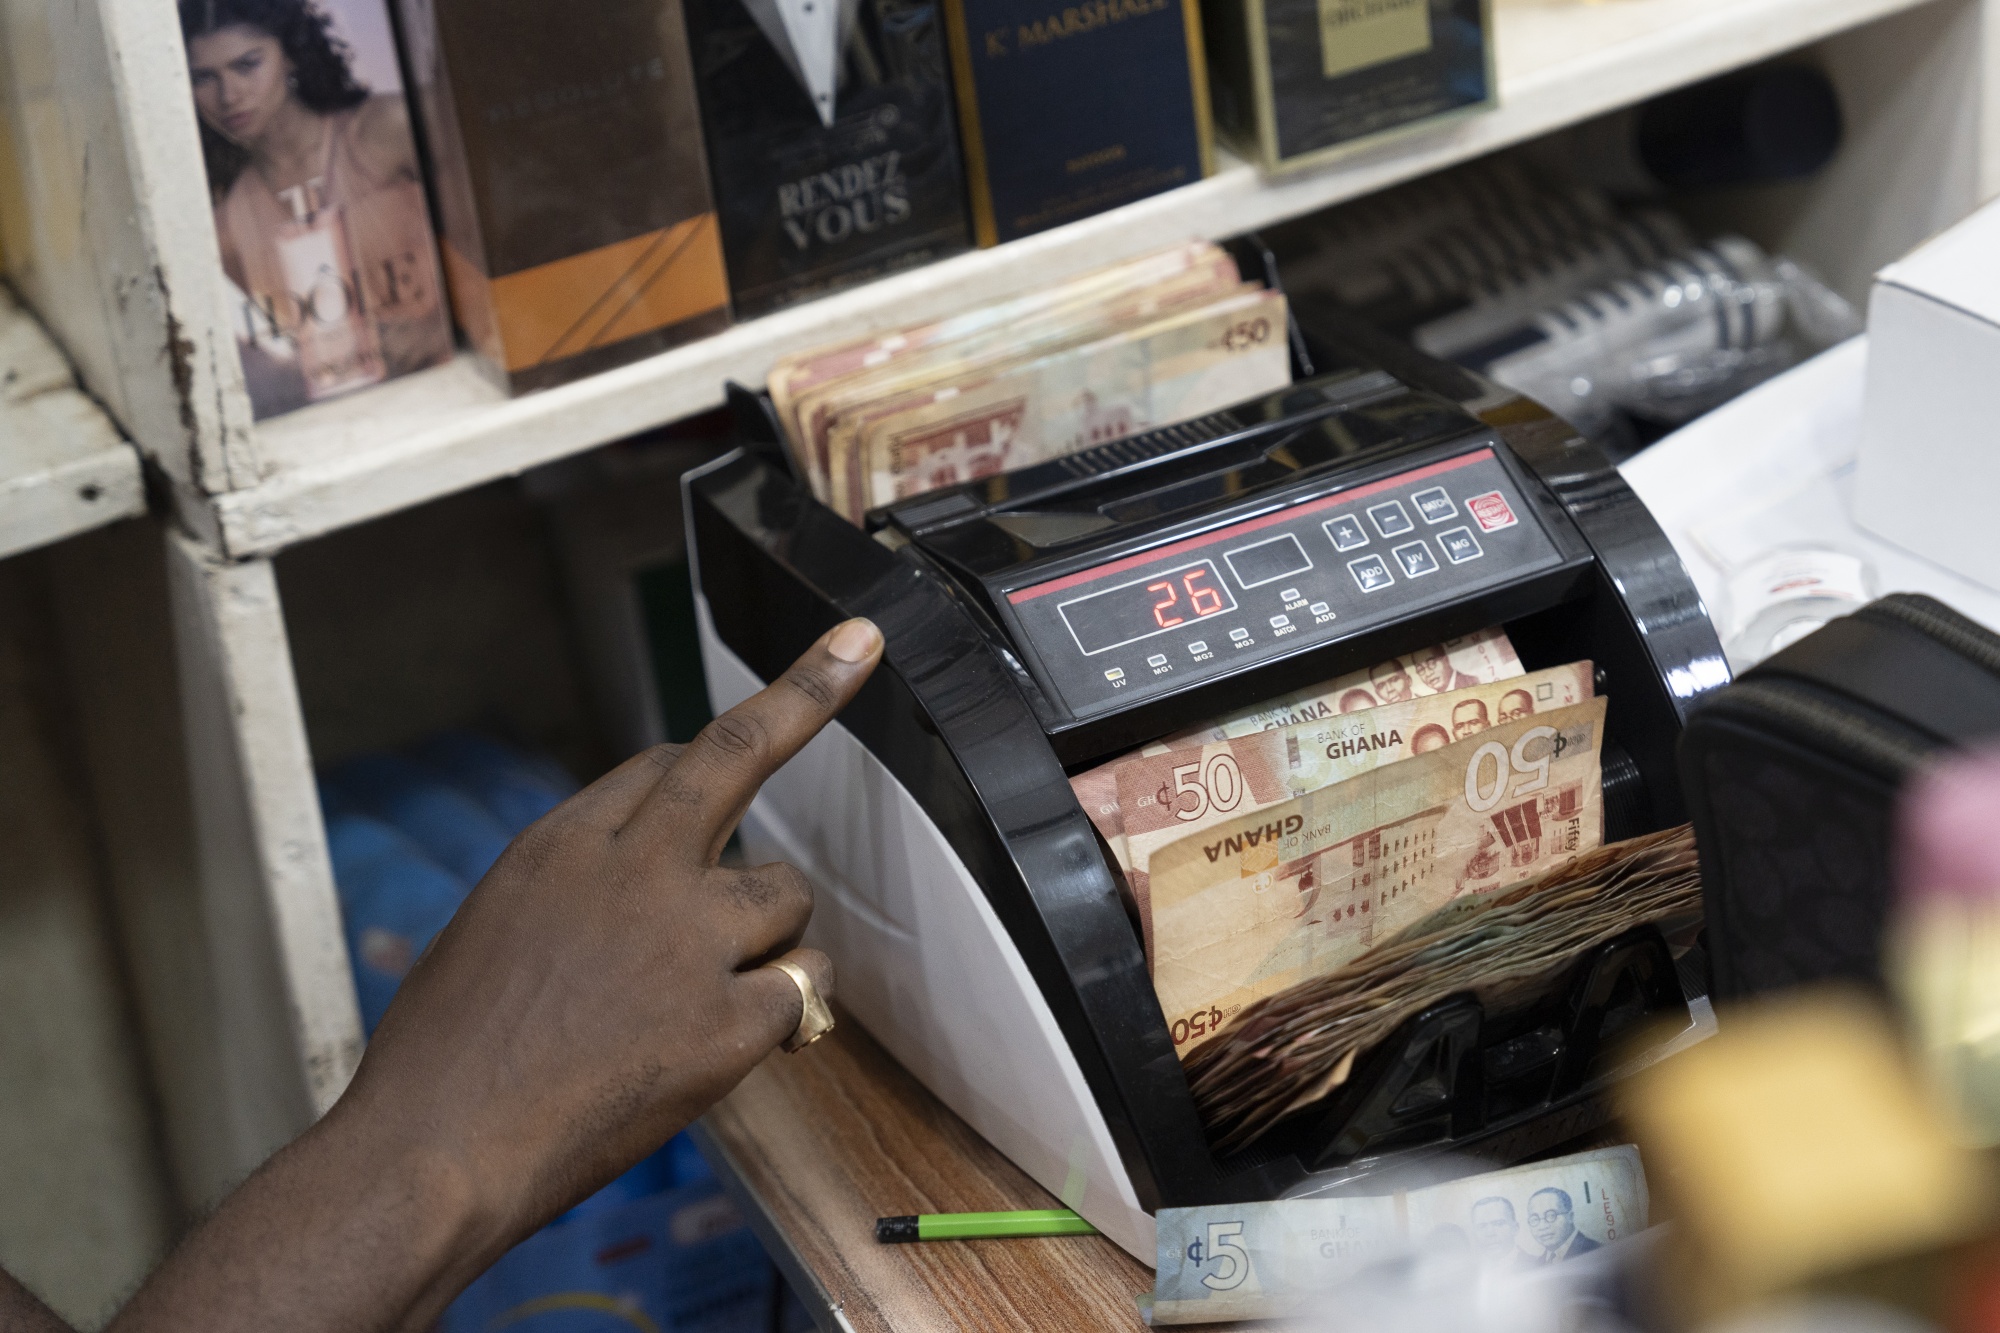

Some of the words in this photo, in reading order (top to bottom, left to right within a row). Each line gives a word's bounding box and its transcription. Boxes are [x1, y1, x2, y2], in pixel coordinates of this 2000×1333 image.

[778, 151, 901, 215] RENDEZ
[783, 180, 911, 250] VOUS
[1450, 538, 1470, 551] MG
[1407, 553, 1424, 565] UV
[1360, 566, 1383, 580] ADD
[1147, 569, 1223, 629] 26
[1285, 598, 1309, 612] ALARM
[1315, 612, 1337, 625] ADD
[1274, 624, 1297, 638] BATCH
[1234, 638, 1255, 650] MG3
[1193, 651, 1215, 663] MG2
[1153, 664, 1174, 676] MG1
[1112, 678, 1127, 689] UV
[1250, 708, 1281, 726] BANK
[1317, 729, 1348, 744] BANK
[1350, 723, 1366, 736] OF
[1326, 729, 1404, 760] GHANA
[1203, 814, 1303, 863] GHANA
[1283, 833, 1299, 849] OF
[1303, 824, 1331, 843] BANK
[1565, 818, 1580, 851] Fifty
